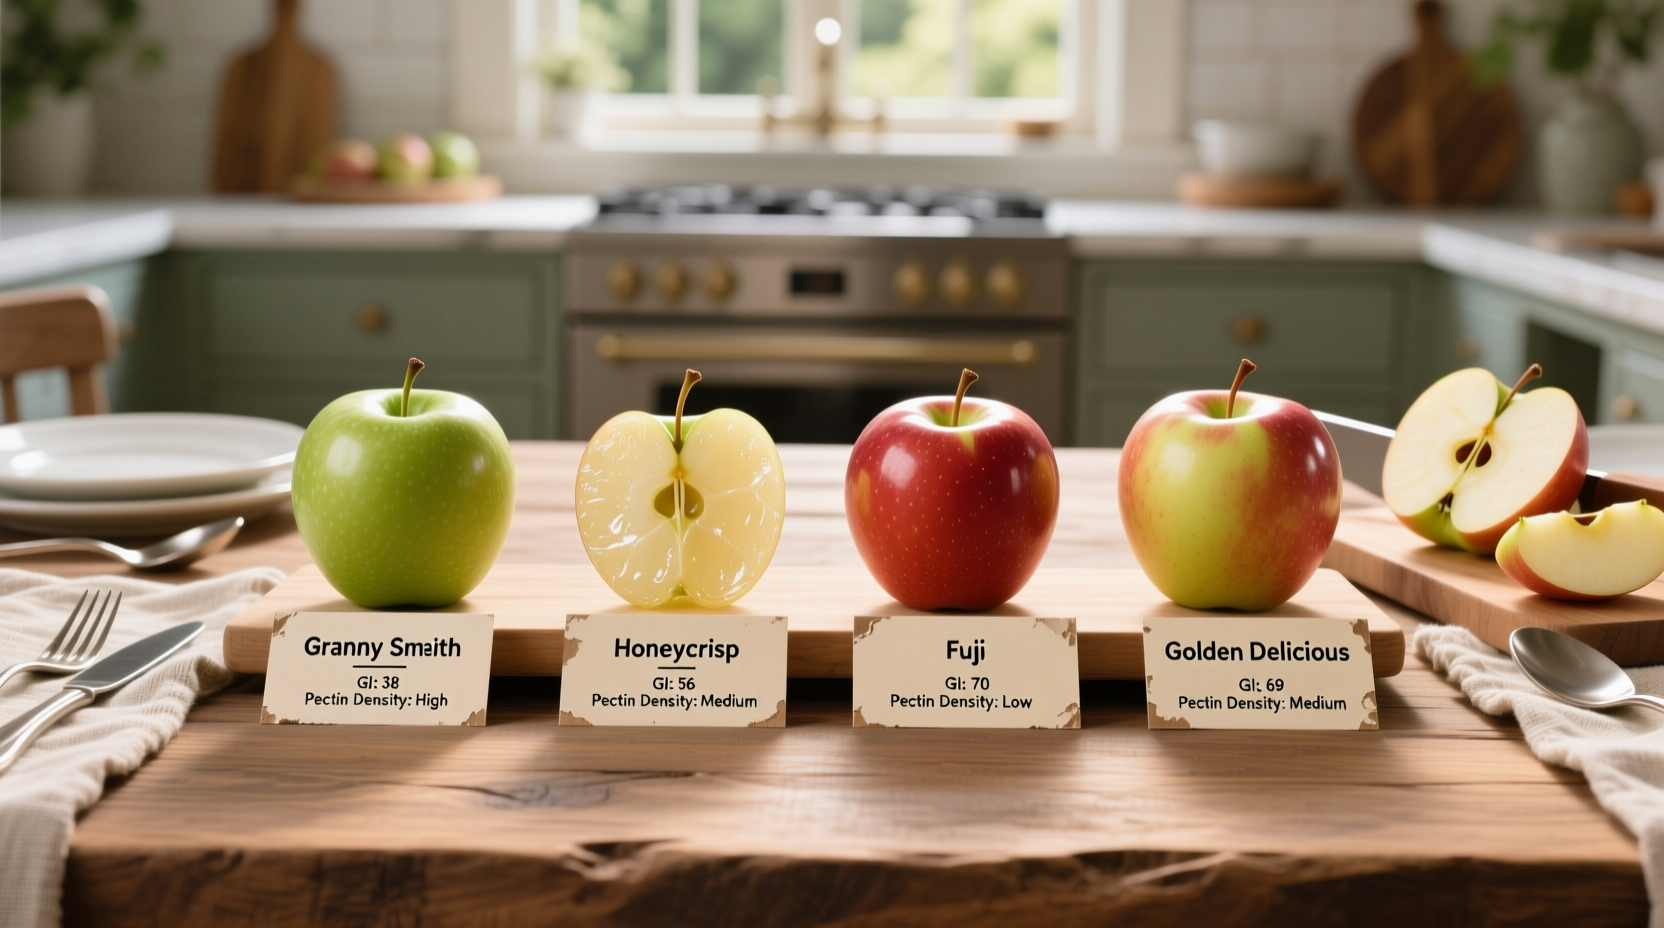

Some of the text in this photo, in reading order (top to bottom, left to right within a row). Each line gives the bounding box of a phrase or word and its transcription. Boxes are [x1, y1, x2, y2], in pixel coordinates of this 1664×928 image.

[303, 636, 384, 662] Granny
[613, 637, 740, 664] Honeycrisp
[945, 638, 986, 666] Fuji
[1164, 640, 1350, 662] Golden Delicious
[381, 675, 400, 690] 38
[678, 676, 696, 691] 56
[970, 676, 990, 691] 70
[1265, 677, 1285, 692] 69
[304, 692, 448, 710] Pectin Density: High
[592, 694, 758, 711] Pectin Density: Medium
[890, 694, 1033, 712] Pectin Density: Low
[1178, 694, 1347, 713] Pectin Density: Medium
